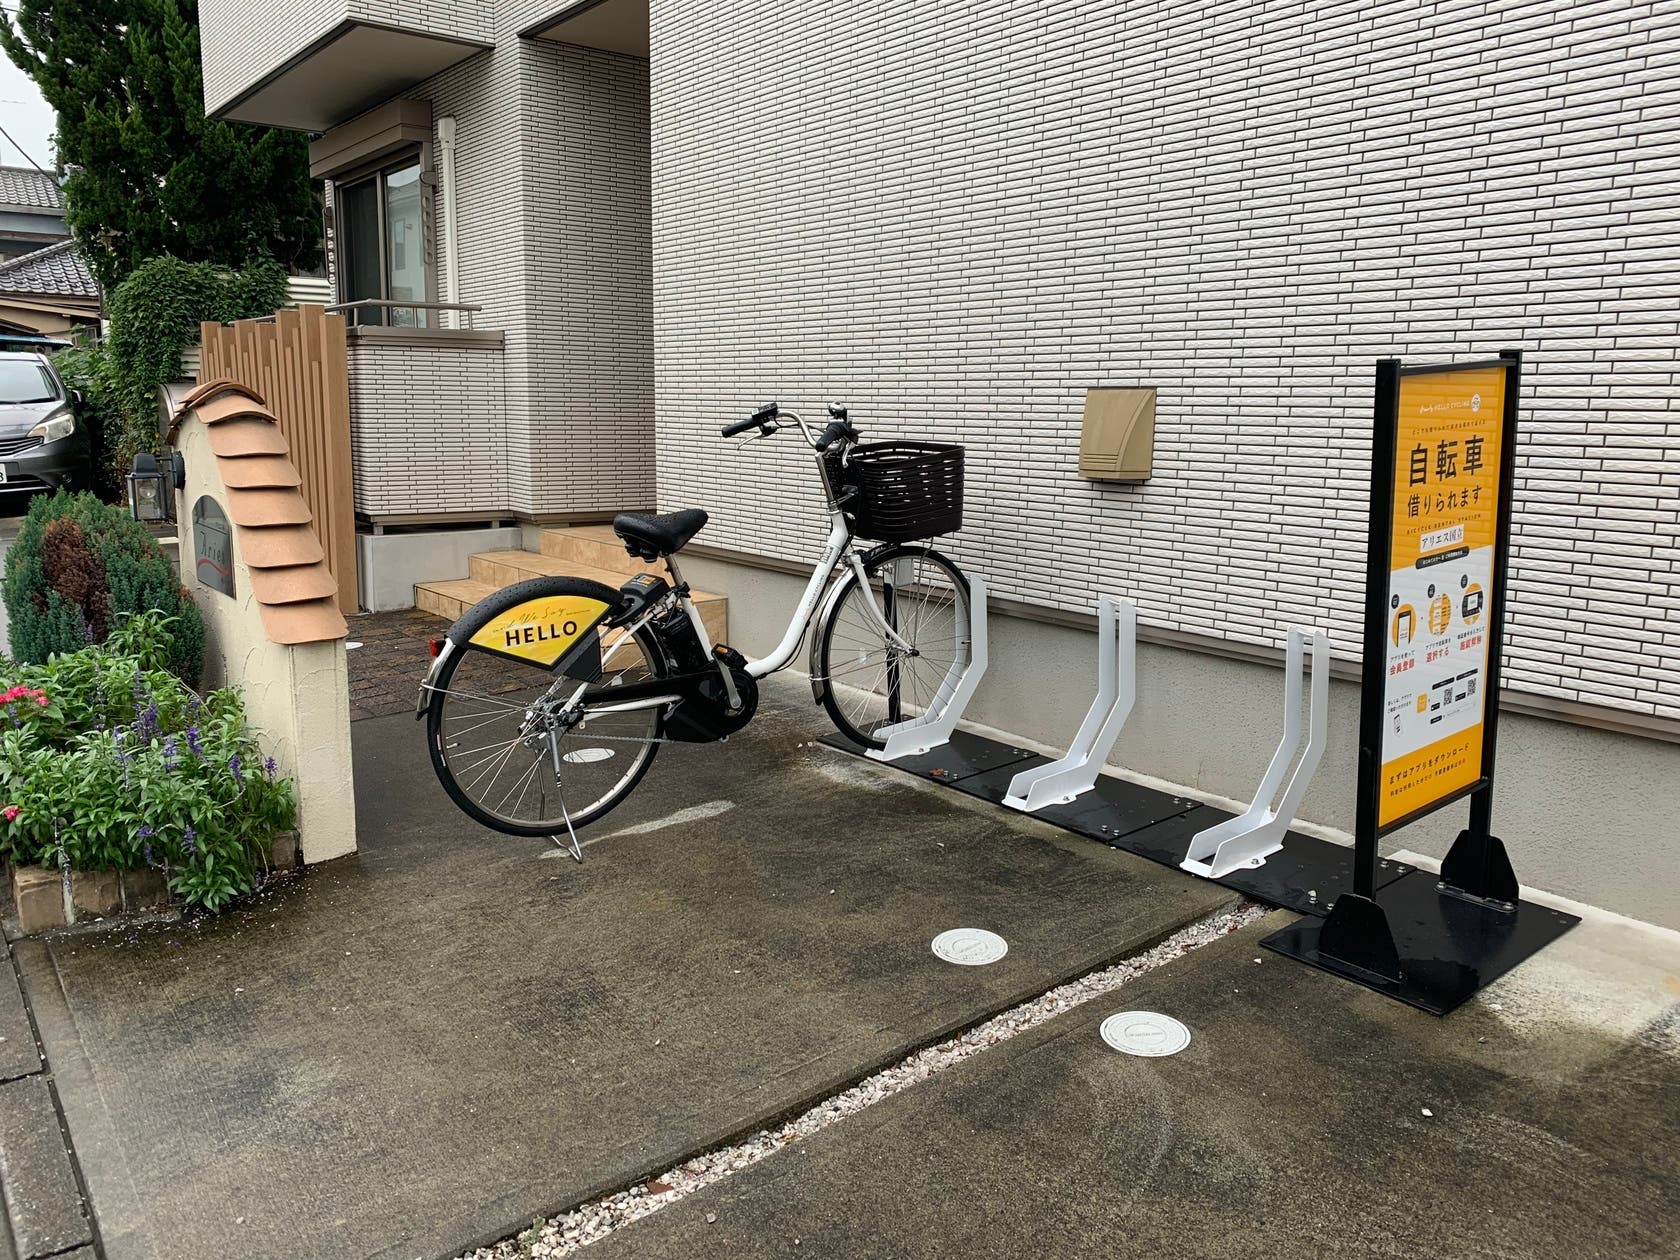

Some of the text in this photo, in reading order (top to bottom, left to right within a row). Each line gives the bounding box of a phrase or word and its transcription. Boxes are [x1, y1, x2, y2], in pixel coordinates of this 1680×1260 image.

[1409, 434, 1484, 487] 自転車
[1407, 485, 1482, 518] 借りられます
[505, 621, 578, 647] HELLO
